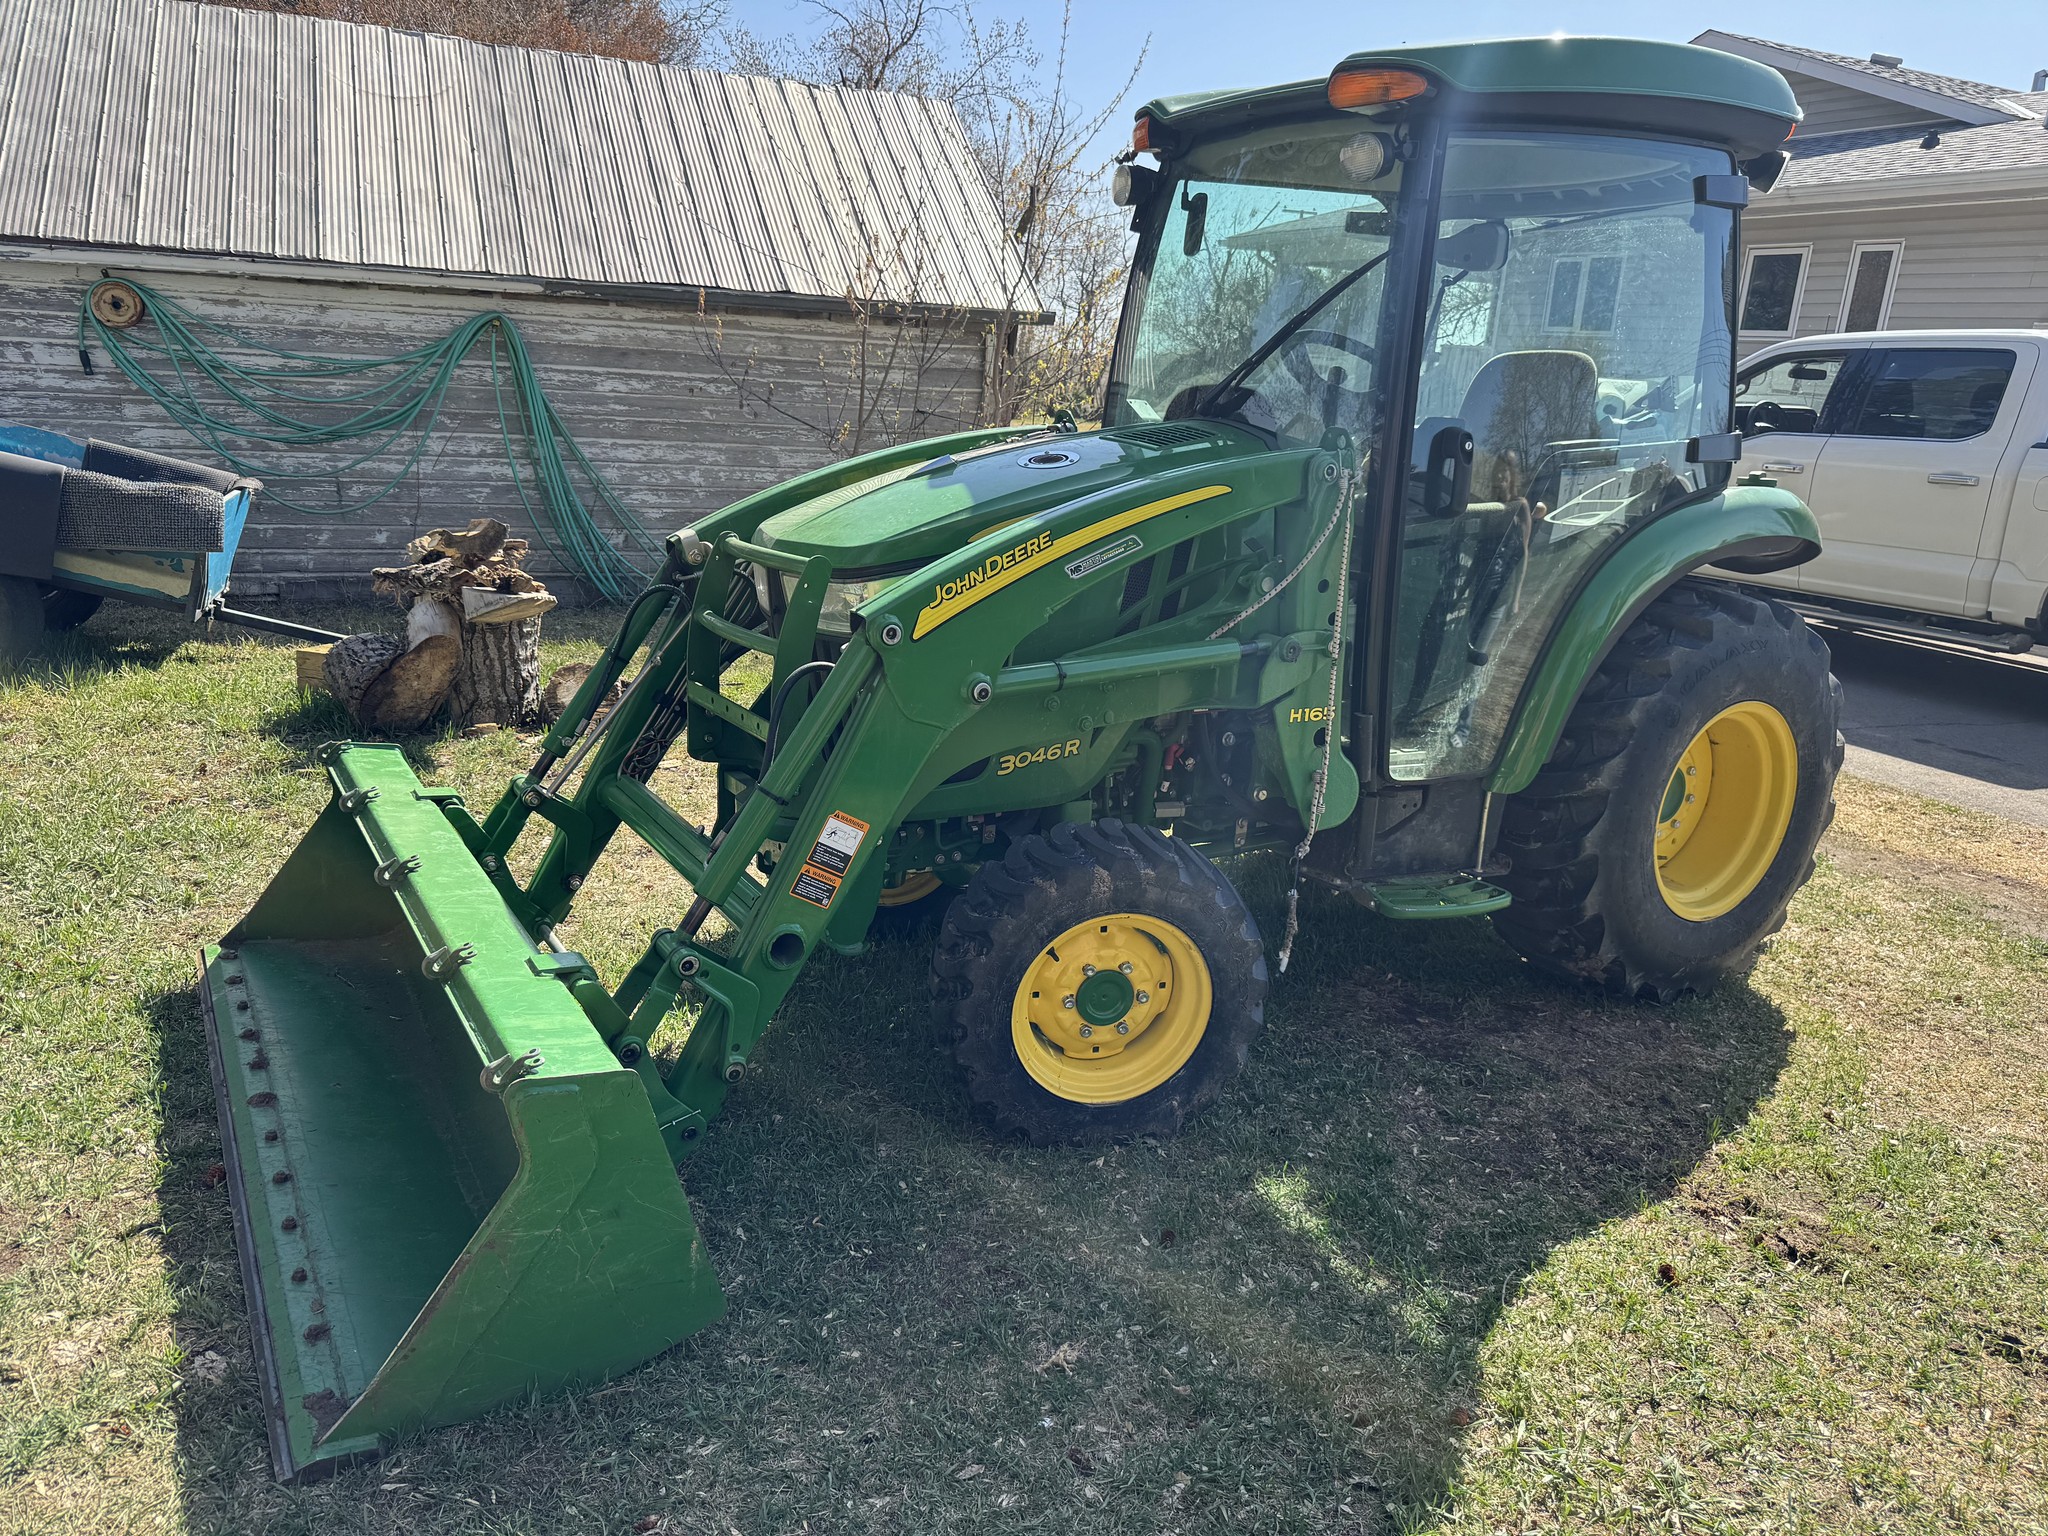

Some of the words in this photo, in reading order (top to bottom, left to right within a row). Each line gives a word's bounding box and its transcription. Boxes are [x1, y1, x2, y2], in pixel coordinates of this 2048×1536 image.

[929, 566, 985, 609] JOHN
[985, 530, 1053, 579] DEERE
[1289, 706, 1336, 723] H165
[840, 815, 865, 830] WARNING
[812, 870, 837, 885] WARNING
